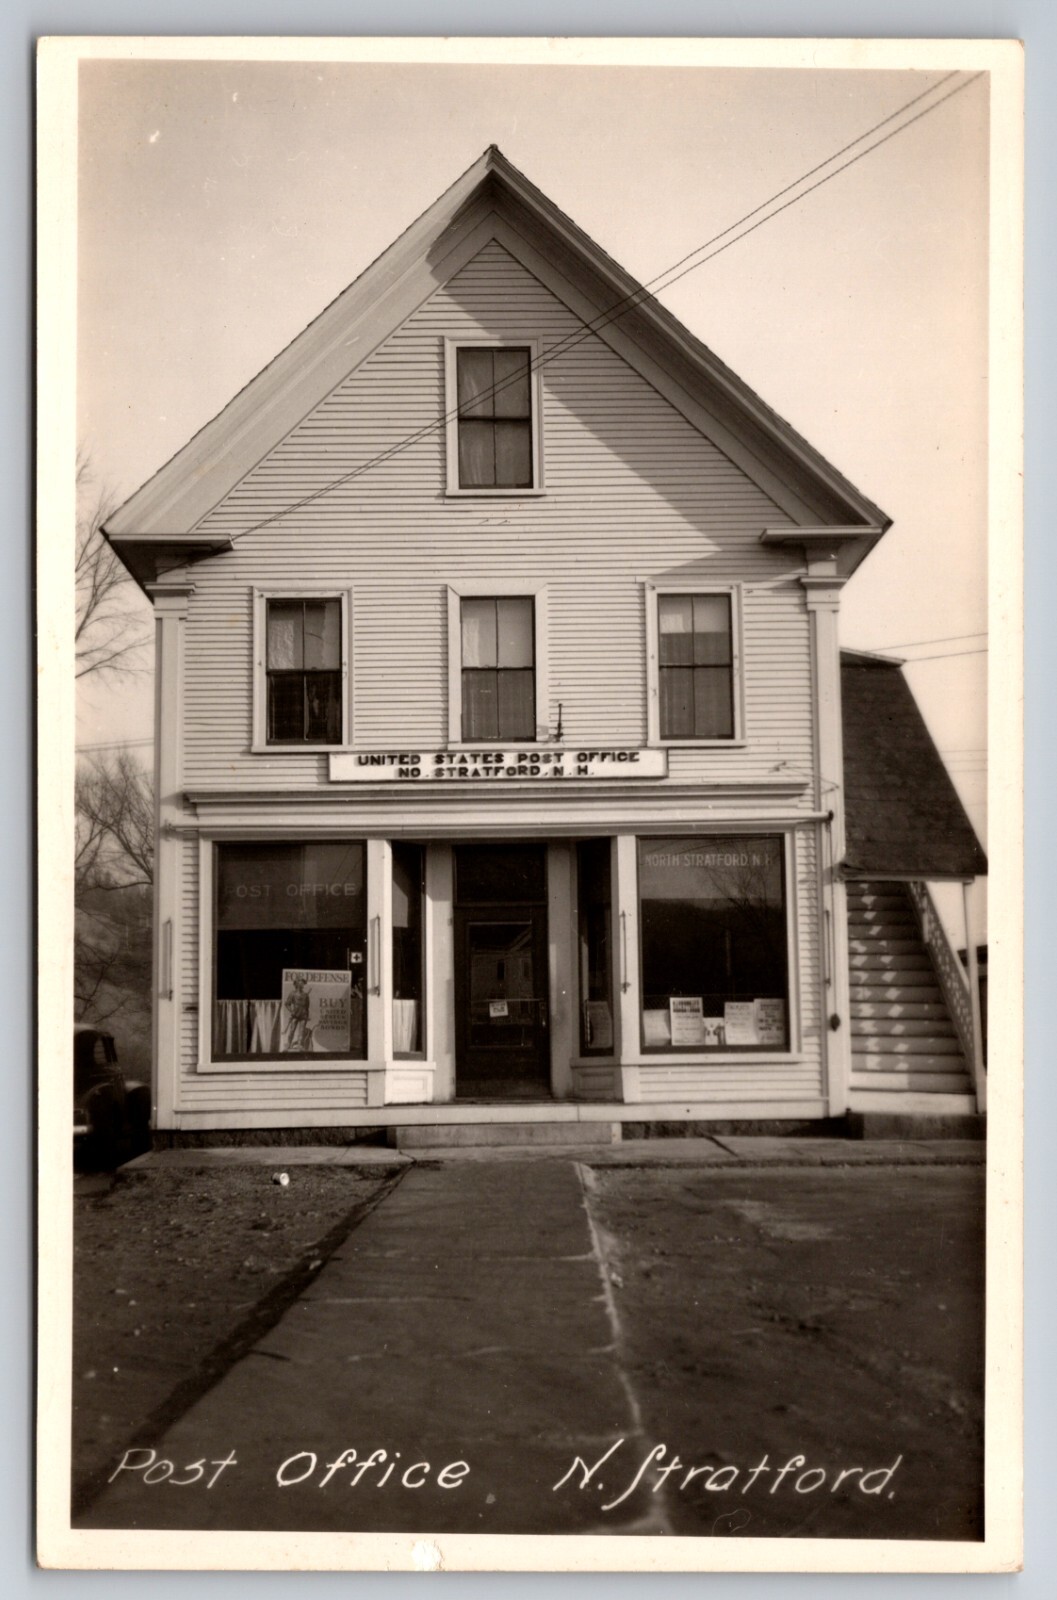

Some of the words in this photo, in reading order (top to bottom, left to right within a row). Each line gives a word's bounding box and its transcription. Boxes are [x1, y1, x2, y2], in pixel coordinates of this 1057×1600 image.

[357, 754, 421, 766] UNITED
[434, 753, 505, 765] STATES
[517, 752, 564, 764] POST
[577, 751, 640, 763] OFFICE
[398, 766, 429, 778] NO.
[645, 853, 680, 867] NORTH
[286, 882, 358, 897] OFFICE
[285, 971, 305, 982] FOR
[306, 972, 350, 983] DEFENSE
[319, 997, 348, 1008] BUY
